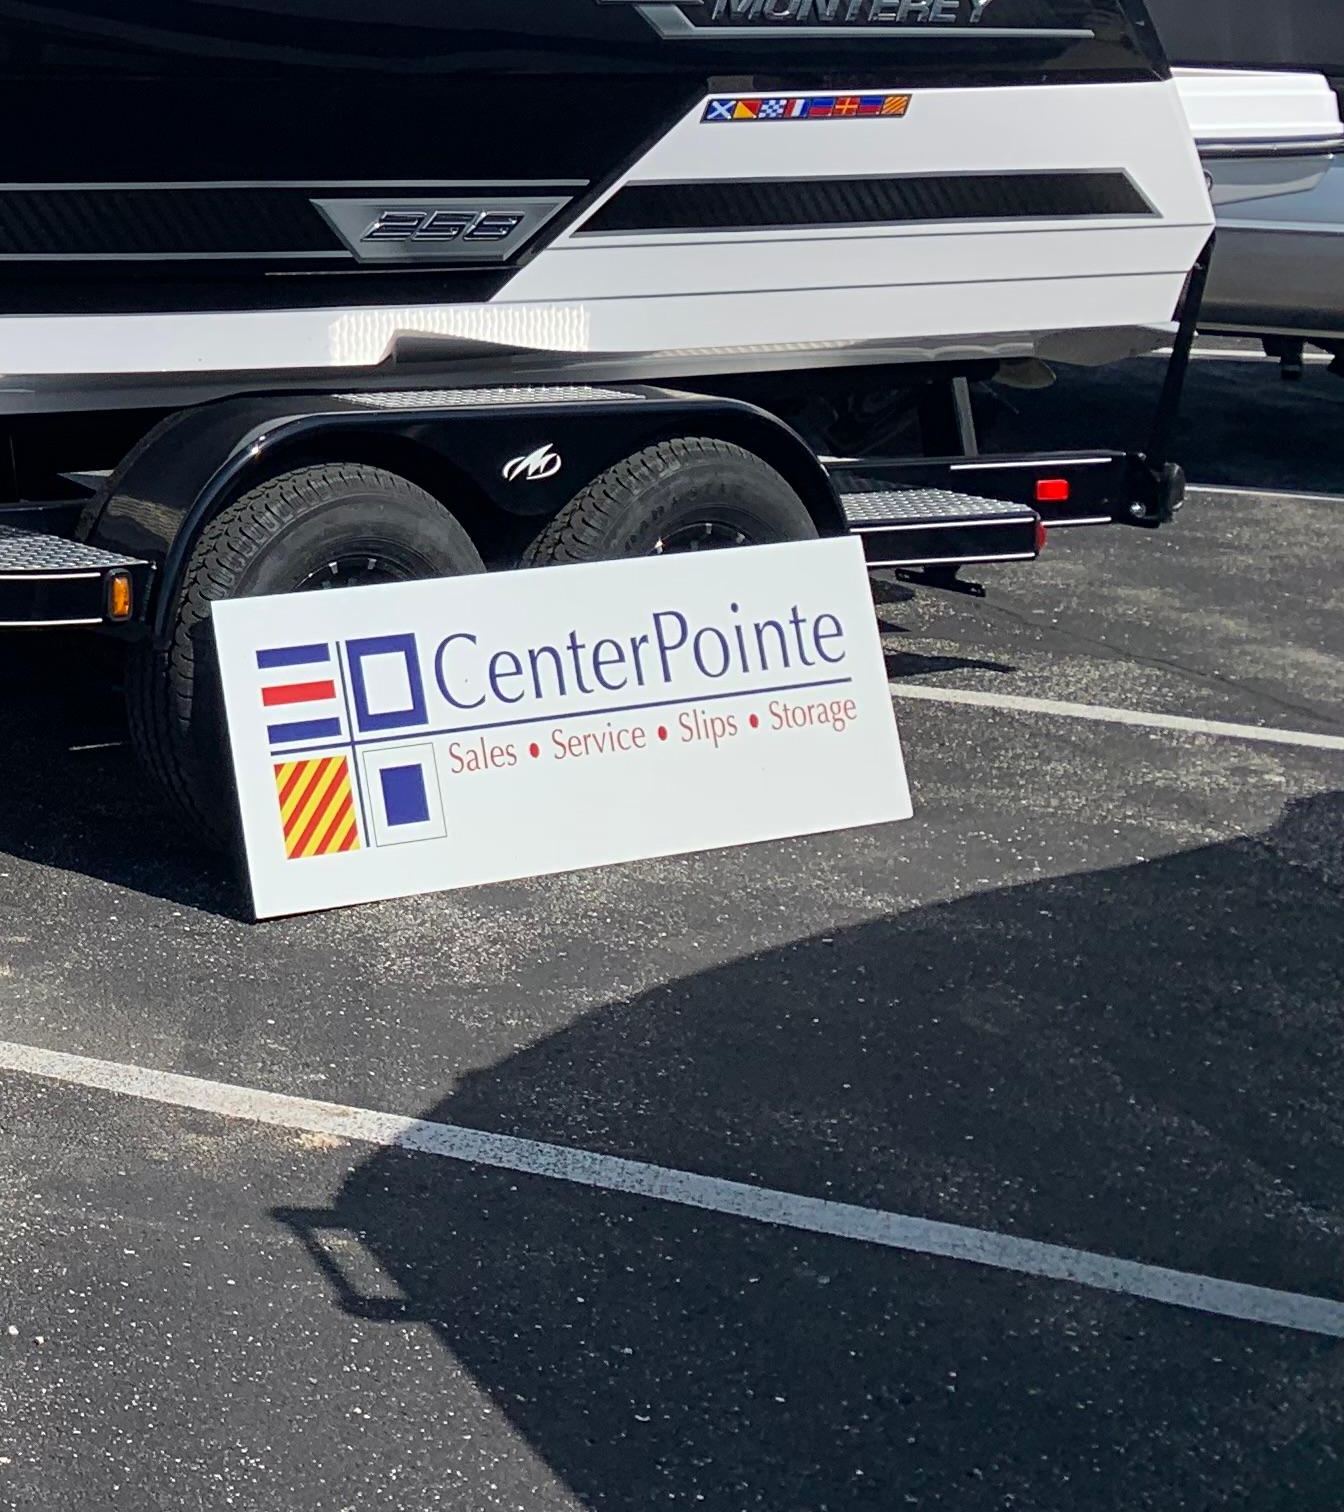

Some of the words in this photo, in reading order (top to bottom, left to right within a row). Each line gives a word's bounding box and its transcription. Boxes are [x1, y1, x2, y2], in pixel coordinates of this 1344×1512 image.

[359, 210, 526, 241] 258
[433, 601, 847, 710] CenterPointe
[448, 737, 518, 774] Sales
[551, 722, 647, 760] Service
[678, 709, 739, 748] Slips
[768, 696, 859, 733] Storage
